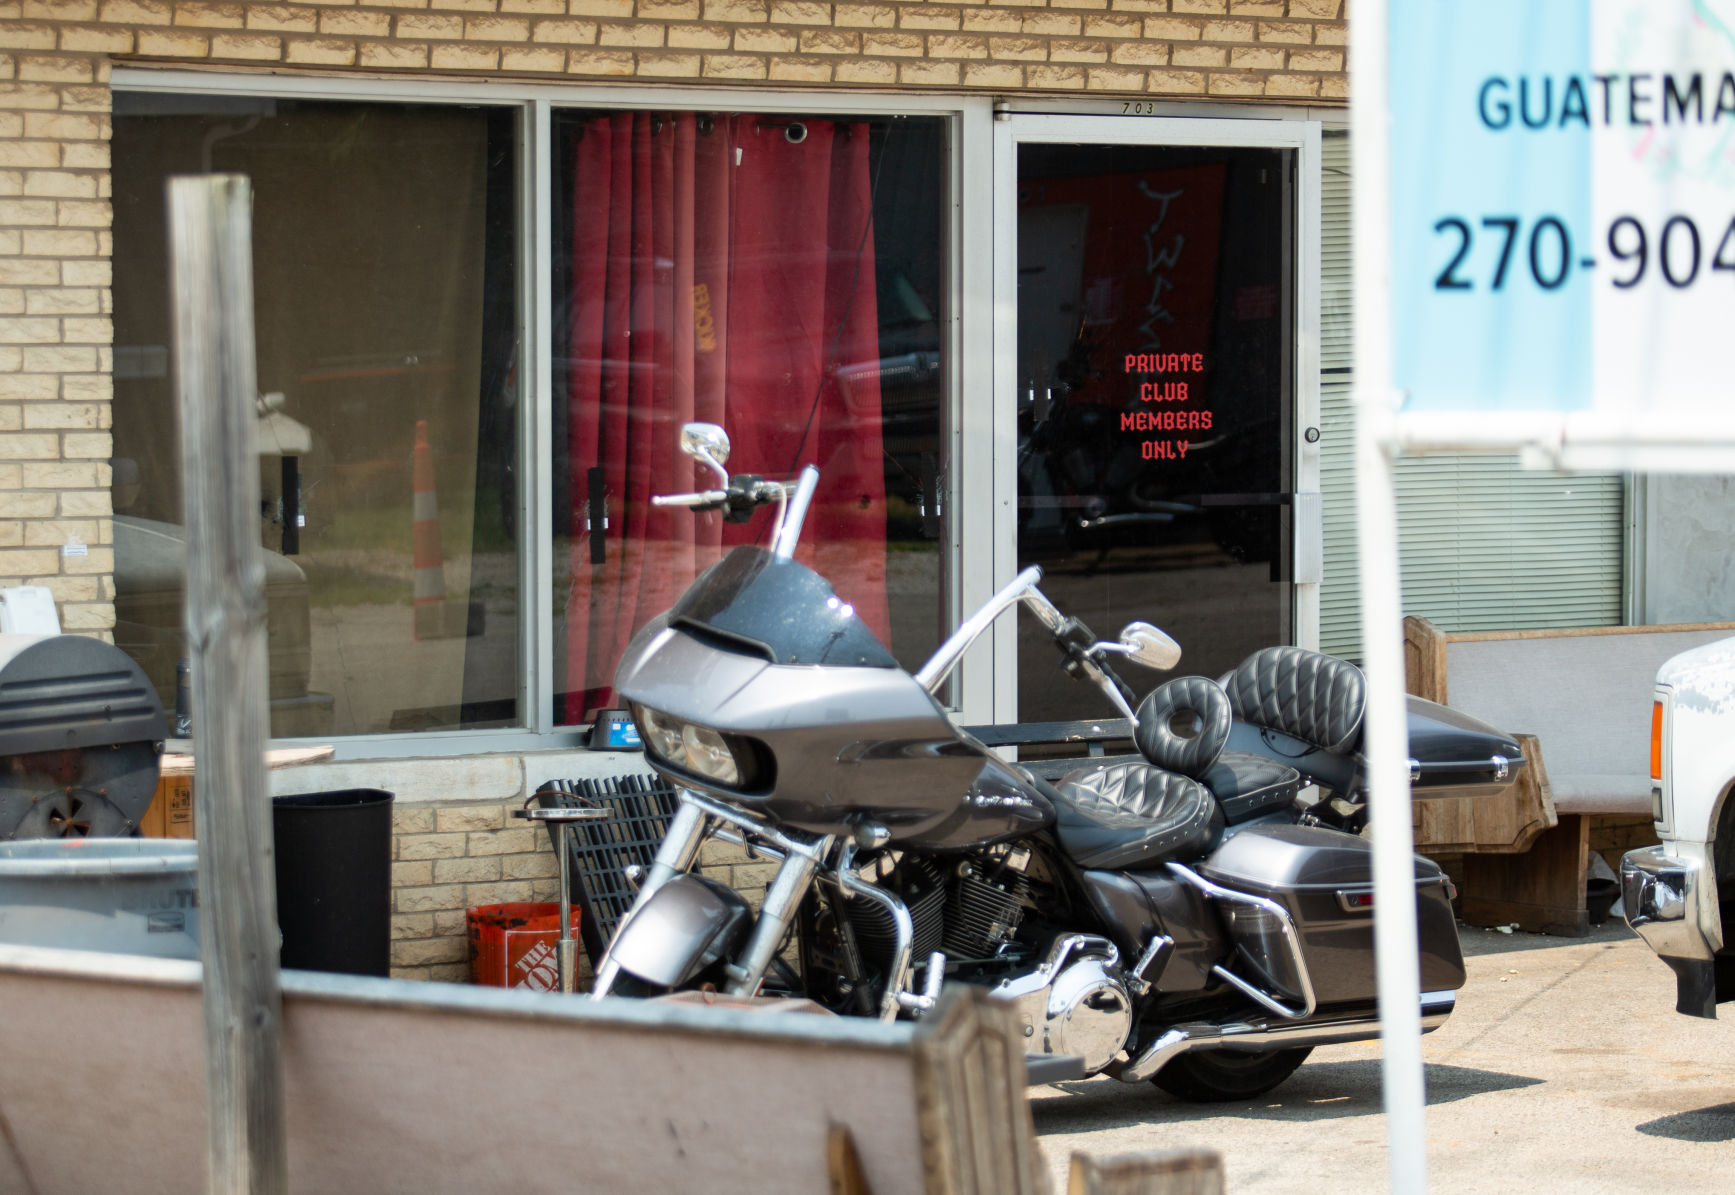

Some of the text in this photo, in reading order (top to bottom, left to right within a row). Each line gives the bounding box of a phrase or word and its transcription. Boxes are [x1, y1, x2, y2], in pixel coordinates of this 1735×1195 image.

[1122, 103, 1153, 114] 703
[1479, 74, 1735, 130] GUATEMA
[1124, 353, 1204, 373] PRIVATE
[1140, 382, 1188, 402] CLUB
[1120, 410, 1213, 431] MEMBERS
[1141, 440, 1189, 460] ONLY
[515, 940, 551, 973] THE
